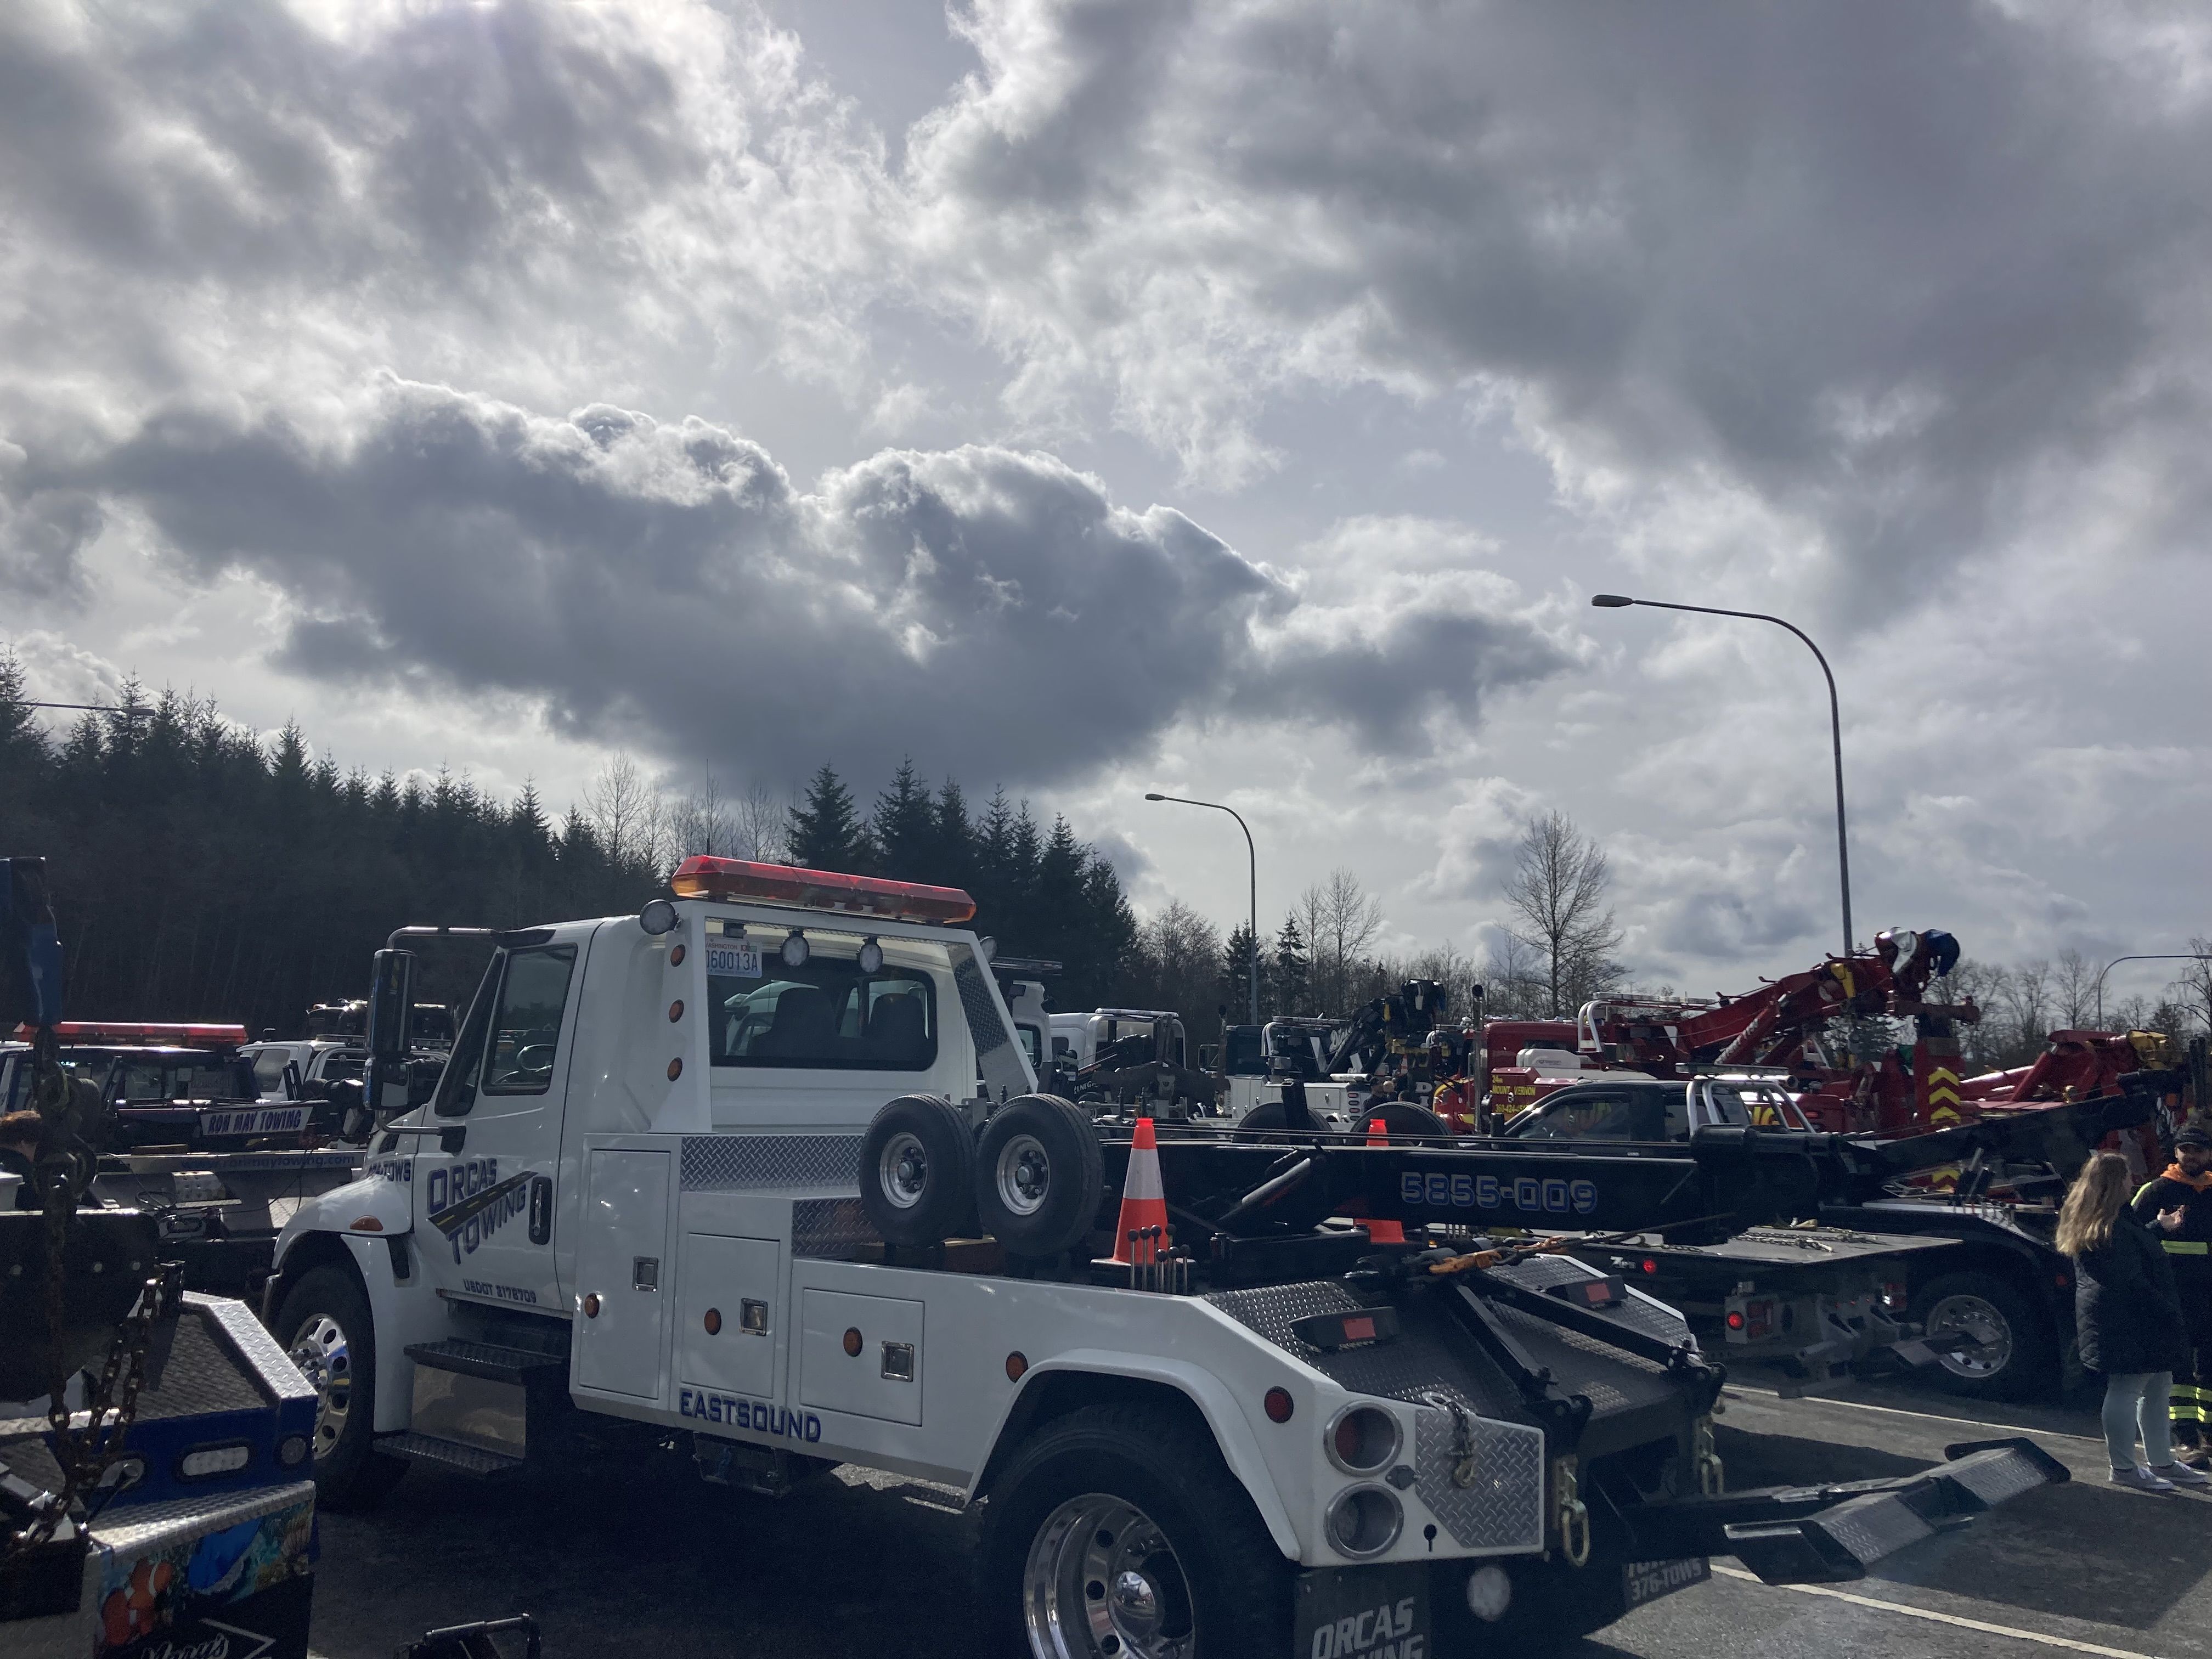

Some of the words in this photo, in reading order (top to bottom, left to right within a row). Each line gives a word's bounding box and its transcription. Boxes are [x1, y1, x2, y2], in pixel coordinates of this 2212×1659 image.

[1492, 1085, 1510, 1094] MOUNT
[1514, 1086, 1536, 1096] VERNON
[208, 1114, 232, 1134] RON
[233, 1111, 258, 1133] MAY
[259, 1109, 302, 1131] TOWING
[427, 1158, 497, 1214] ORCAS
[1401, 1172, 1598, 1214] 5855-009
[446, 1183, 526, 1265] TOWING
[463, 1278, 493, 1295] USDOT
[679, 1387, 821, 1442] EASTSOUND
[1631, 1559, 1702, 1601] 376-TOWS
[1311, 1596, 1415, 1659] ORCAS
